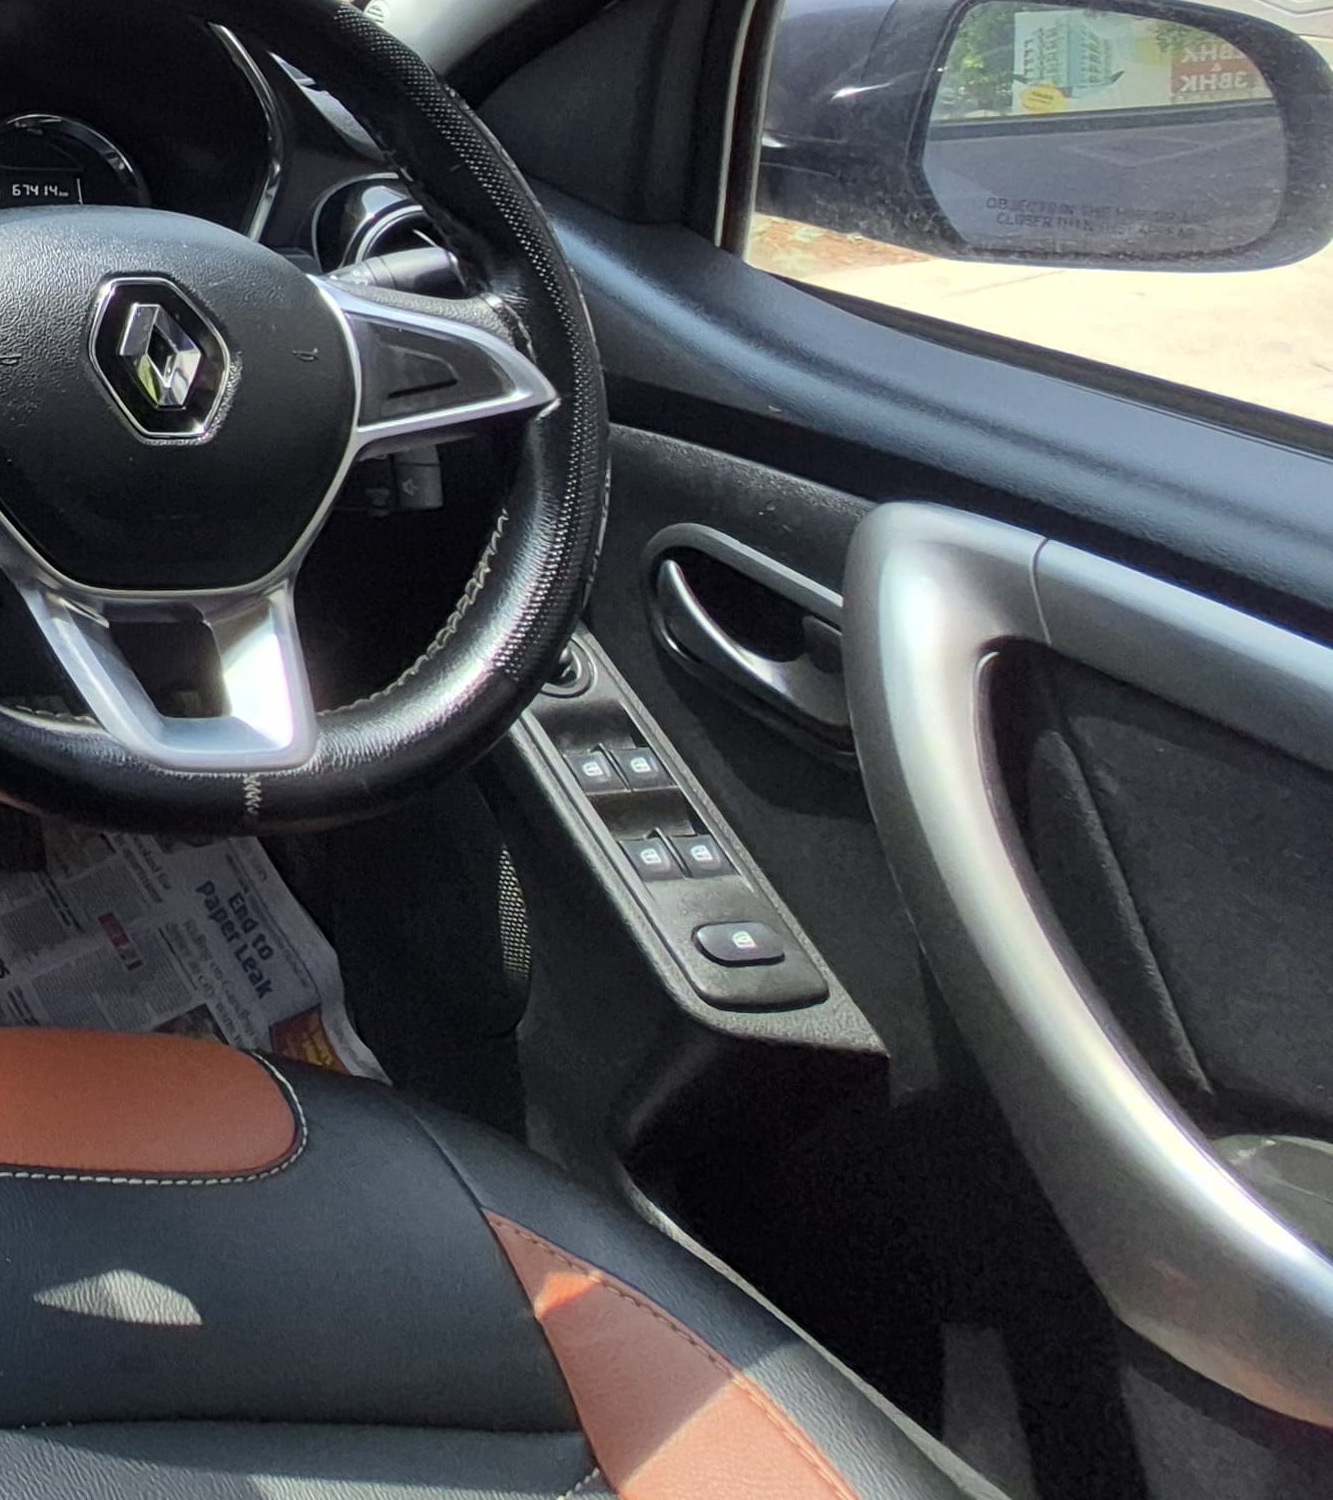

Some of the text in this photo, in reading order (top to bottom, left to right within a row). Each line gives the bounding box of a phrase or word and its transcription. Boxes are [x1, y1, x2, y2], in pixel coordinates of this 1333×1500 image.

[12, 183, 58, 197] 67414
[196, 880, 242, 943] Paper
[235, 944, 273, 999] Leak
[228, 891, 259, 935] End
[252, 933, 274, 961] to
